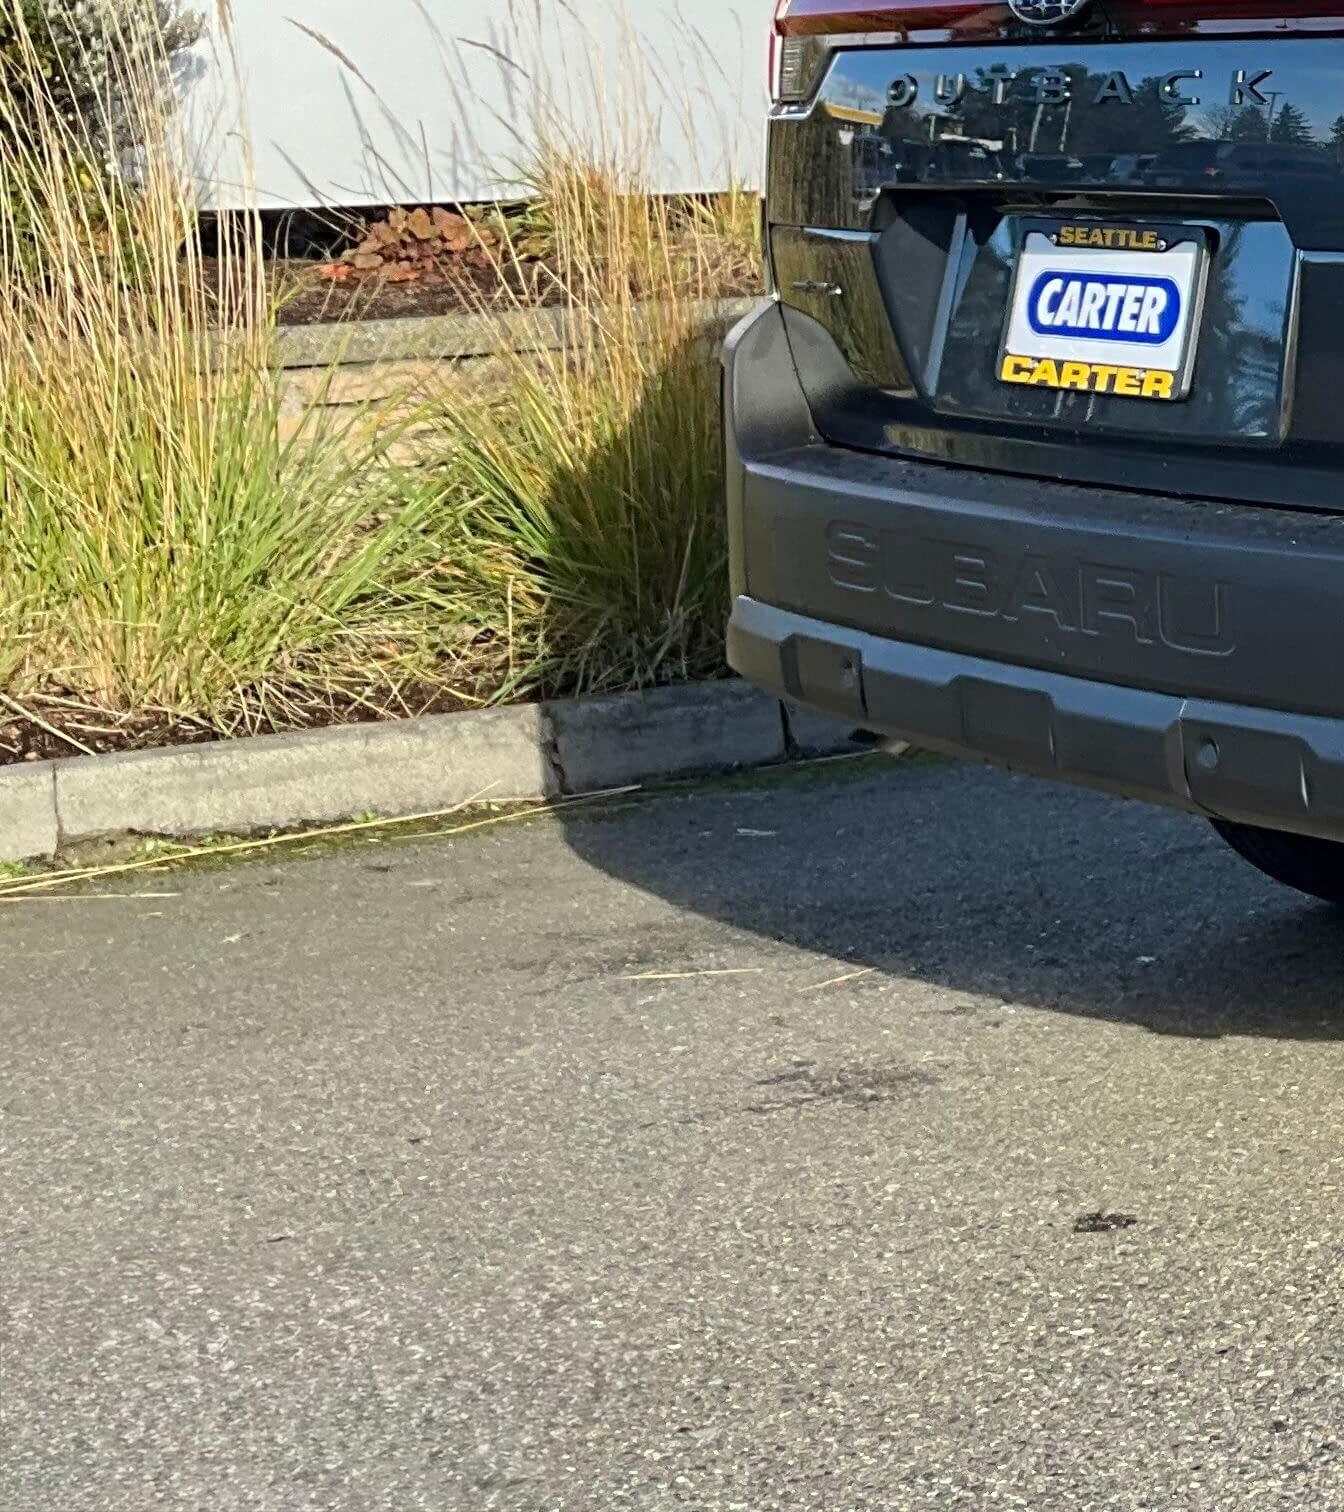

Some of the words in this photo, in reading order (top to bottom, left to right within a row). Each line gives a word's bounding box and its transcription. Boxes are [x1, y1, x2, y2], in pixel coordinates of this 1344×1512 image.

[885, 67, 1275, 107] OUTBACK
[1059, 225, 1158, 250] SEATTLE
[1036, 277, 1170, 335] CARTER
[1001, 355, 1174, 400] CARTER
[826, 519, 1237, 657] SUBARU
